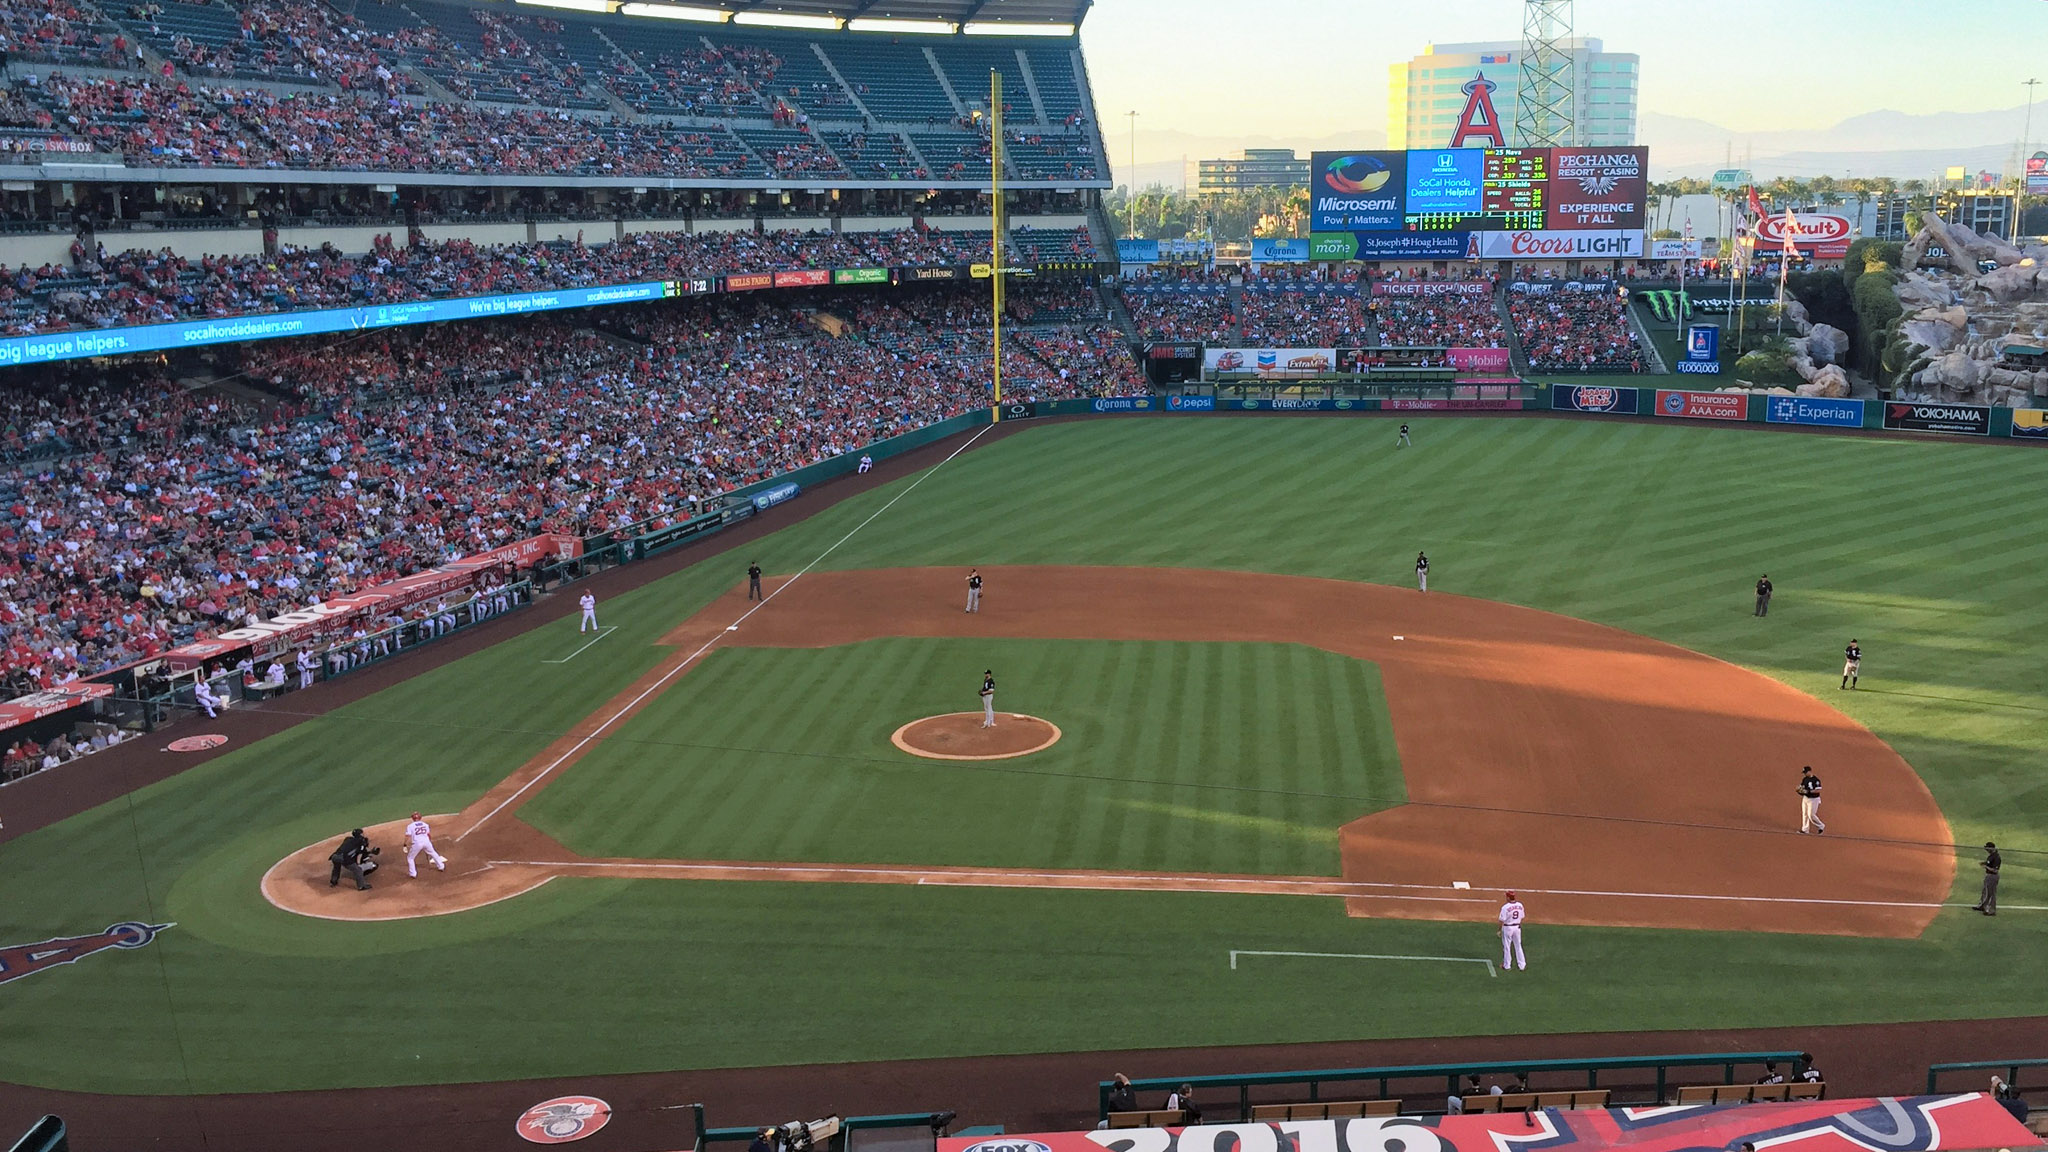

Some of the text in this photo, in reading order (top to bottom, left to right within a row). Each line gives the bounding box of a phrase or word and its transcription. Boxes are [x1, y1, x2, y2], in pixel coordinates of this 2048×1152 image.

[49, 140, 92, 153] SKYBOX
[1558, 155, 1639, 167] PECHANGA
[1558, 167, 1639, 176] RESORT CASINO
[1419, 177, 1471, 187] SoCal Honda
[1411, 187, 1478, 199] Dealers Helpful
[1559, 203, 1635, 213] EXPERIENCE
[1323, 216, 1353, 224] Powr
[1577, 214, 1615, 224] IT ALL
[1773, 222, 1837, 235] Yakult
[1411, 238, 1432, 247] Hoag
[1432, 237, 1459, 246] Health
[1512, 231, 1632, 254] Coors LIGHT
[1133, 244, 1152, 252] your
[1264, 246, 1296, 255] Corona
[1316, 243, 1351, 253] more
[933, 269, 952, 277] House
[990, 266, 1032, 274] gneration.com
[693, 280, 707, 291] 7:22
[729, 276, 771, 287] WELLS FARGO
[1382, 283, 1483, 293] TICKET EXCHANGE
[469, 295, 559, 313] We're big league helpers.
[184, 319, 302, 341] socalhondadealers.com
[25, 341, 72, 359] league
[76, 335, 128, 352] helpers.
[1151, 346, 1174, 358] JMG
[1678, 364, 1719, 373] $1,000,000
[1578, 387, 1611, 398] Jersey
[1184, 399, 1210, 408] pepsi
[1690, 394, 1738, 405] Insurance
[1095, 399, 1130, 412] Corona
[1690, 406, 1738, 416] AAA.com
[1799, 404, 1854, 420] Experian
[1912, 407, 1981, 421] YOKOHAMA
[522, 541, 541, 554] INC.
[42, 702, 68, 716] StateFarm
[0, 718, 19, 730] teFarm
[414, 827, 427, 836] 25
[1512, 911, 1519, 919] 9
